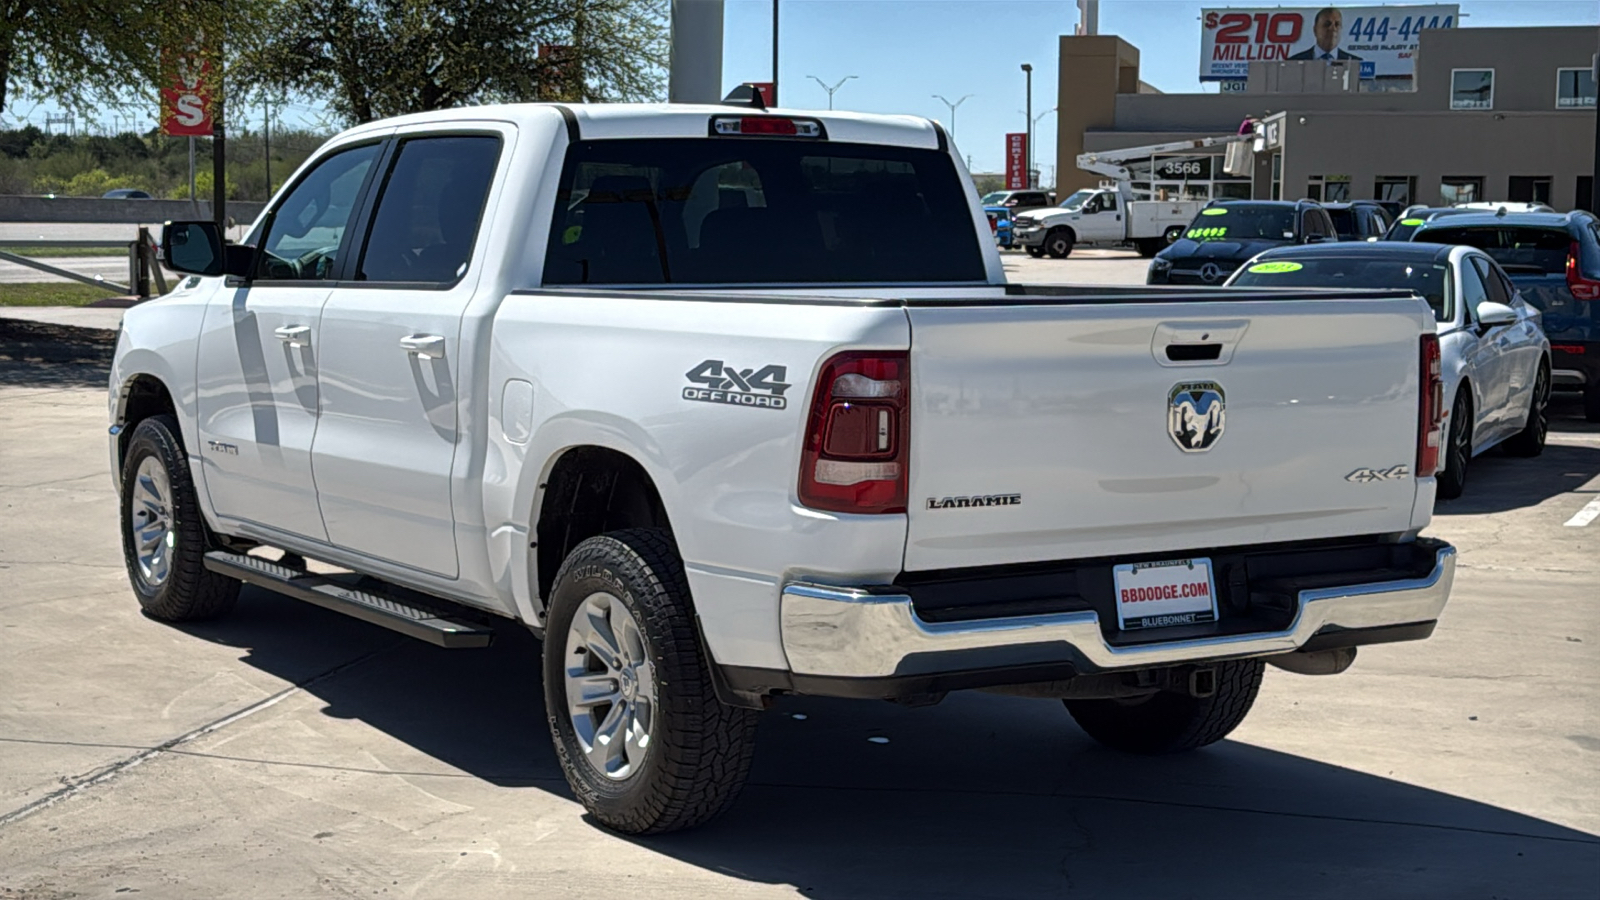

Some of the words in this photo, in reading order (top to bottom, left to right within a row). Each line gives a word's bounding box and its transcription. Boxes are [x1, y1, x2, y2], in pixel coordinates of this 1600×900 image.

[1205, 11, 1303, 44] $210
[1212, 44, 1290, 61] MILLION
[1011, 135, 1022, 188] CERTIFIED
[1165, 161, 1201, 175] 3566
[684, 388, 723, 401] OFF
[726, 393, 785, 408] ROAD
[926, 493, 1021, 510] LARAMIE
[1121, 582, 1208, 603] BBDODGE.COM
[1141, 613, 1196, 627] BLUEBONNET
